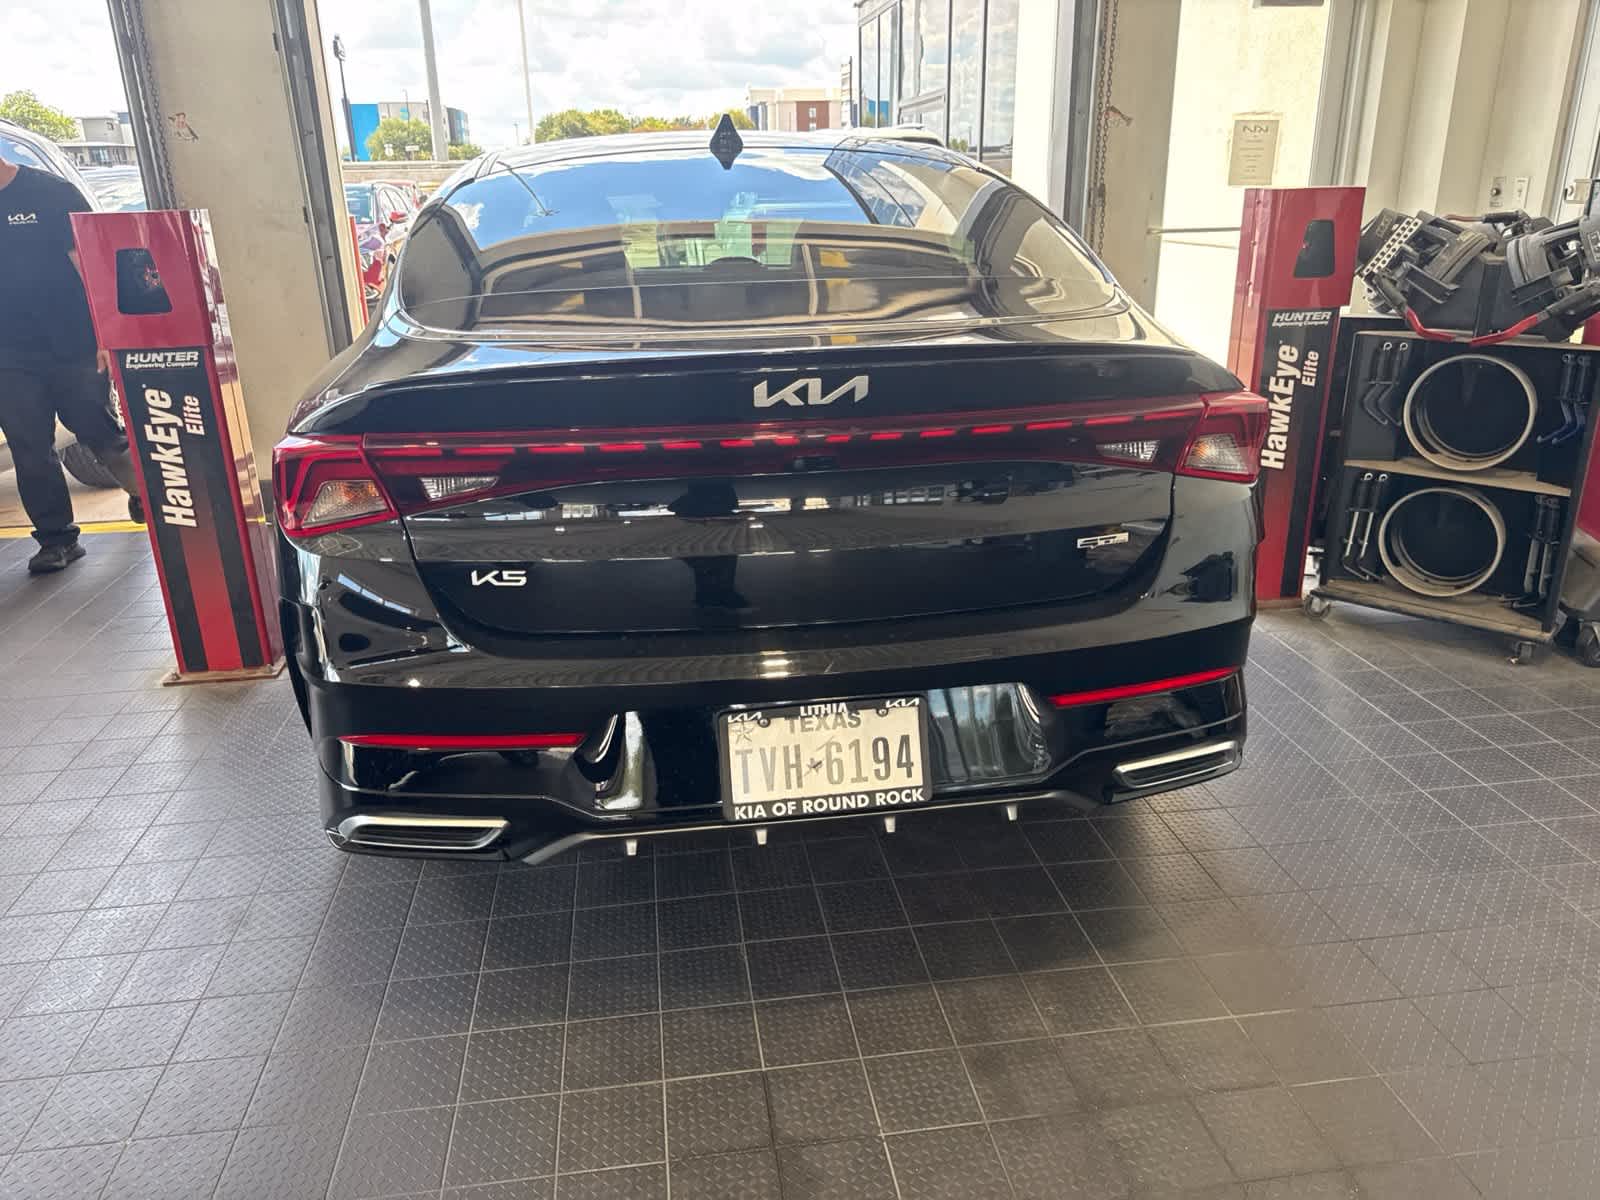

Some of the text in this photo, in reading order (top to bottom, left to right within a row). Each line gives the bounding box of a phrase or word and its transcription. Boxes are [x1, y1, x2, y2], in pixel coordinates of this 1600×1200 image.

[1273, 311, 1332, 321] HUNTER
[126, 351, 199, 363] HUNTER
[126, 361, 165, 370] Engineering
[1301, 350, 1319, 387] Elite
[753, 375, 869, 408] KIA
[183, 394, 205, 436] Elite
[1260, 344, 1301, 470] HawkEye
[144, 388, 198, 527] HawkEye
[471, 570, 527, 586] K5
[800, 702, 847, 717] LITHIA
[885, 698, 920, 708] KIA
[728, 711, 762, 723] KIA
[784, 711, 862, 734] TEXAS
[735, 734, 914, 794] TVH 6194
[735, 788, 925, 821] KIA OF ROUND ROCK
